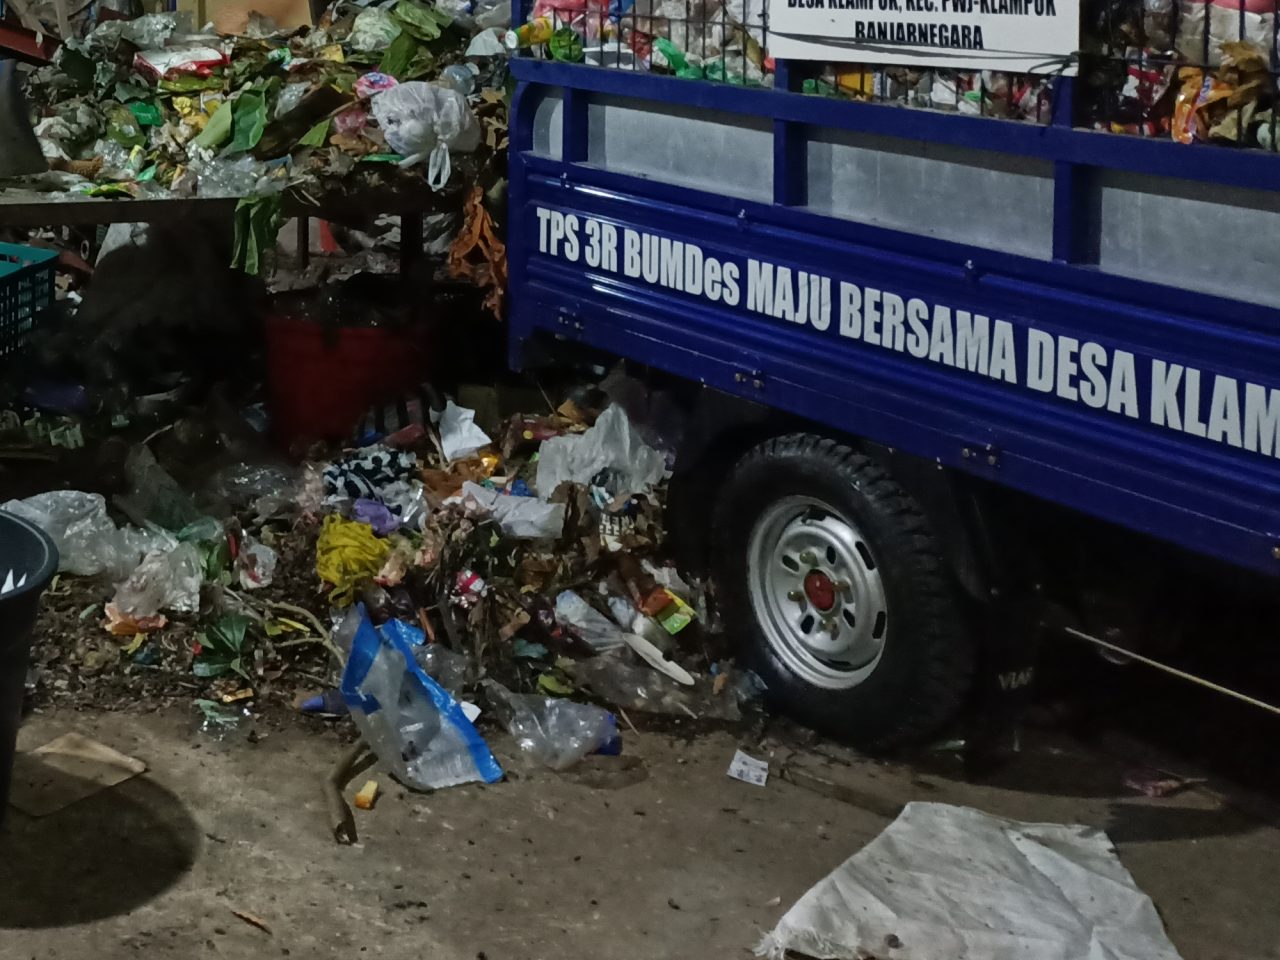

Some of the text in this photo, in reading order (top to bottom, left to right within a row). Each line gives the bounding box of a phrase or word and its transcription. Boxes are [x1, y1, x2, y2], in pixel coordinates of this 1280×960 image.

[855, 21, 984, 50] BANJARNEGARA
[536, 207, 1280, 459] TPS 3R BUMDes MAJU BERSAMA DESA KLAM
